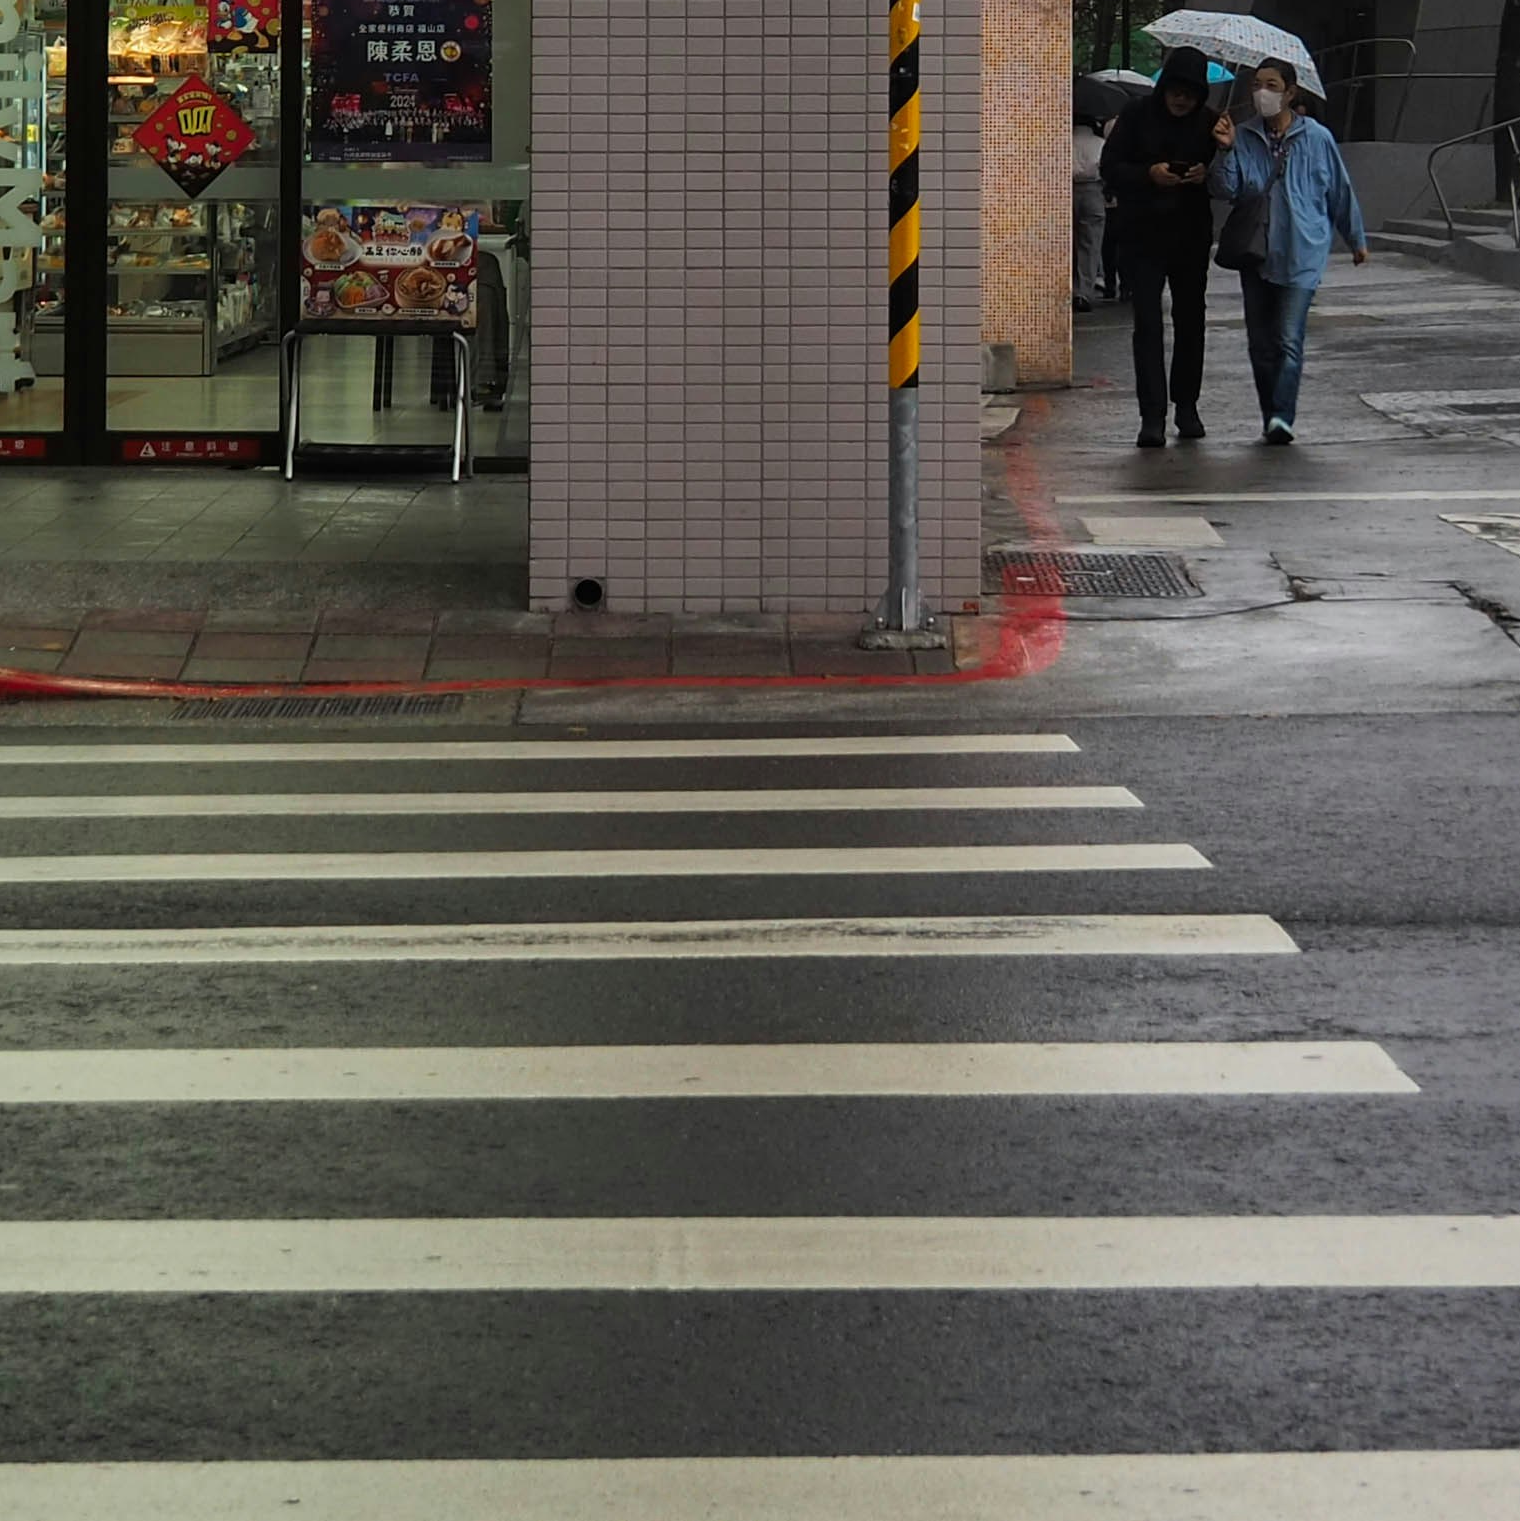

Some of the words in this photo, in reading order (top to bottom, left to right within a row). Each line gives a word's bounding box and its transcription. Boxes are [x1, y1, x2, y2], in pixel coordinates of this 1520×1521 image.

[357, 22, 415, 34] 全家便利商店
[366, 39, 439, 64] 陳柔恩
[382, 71, 420, 82] TCFA
[390, 93, 416, 108] 2024
